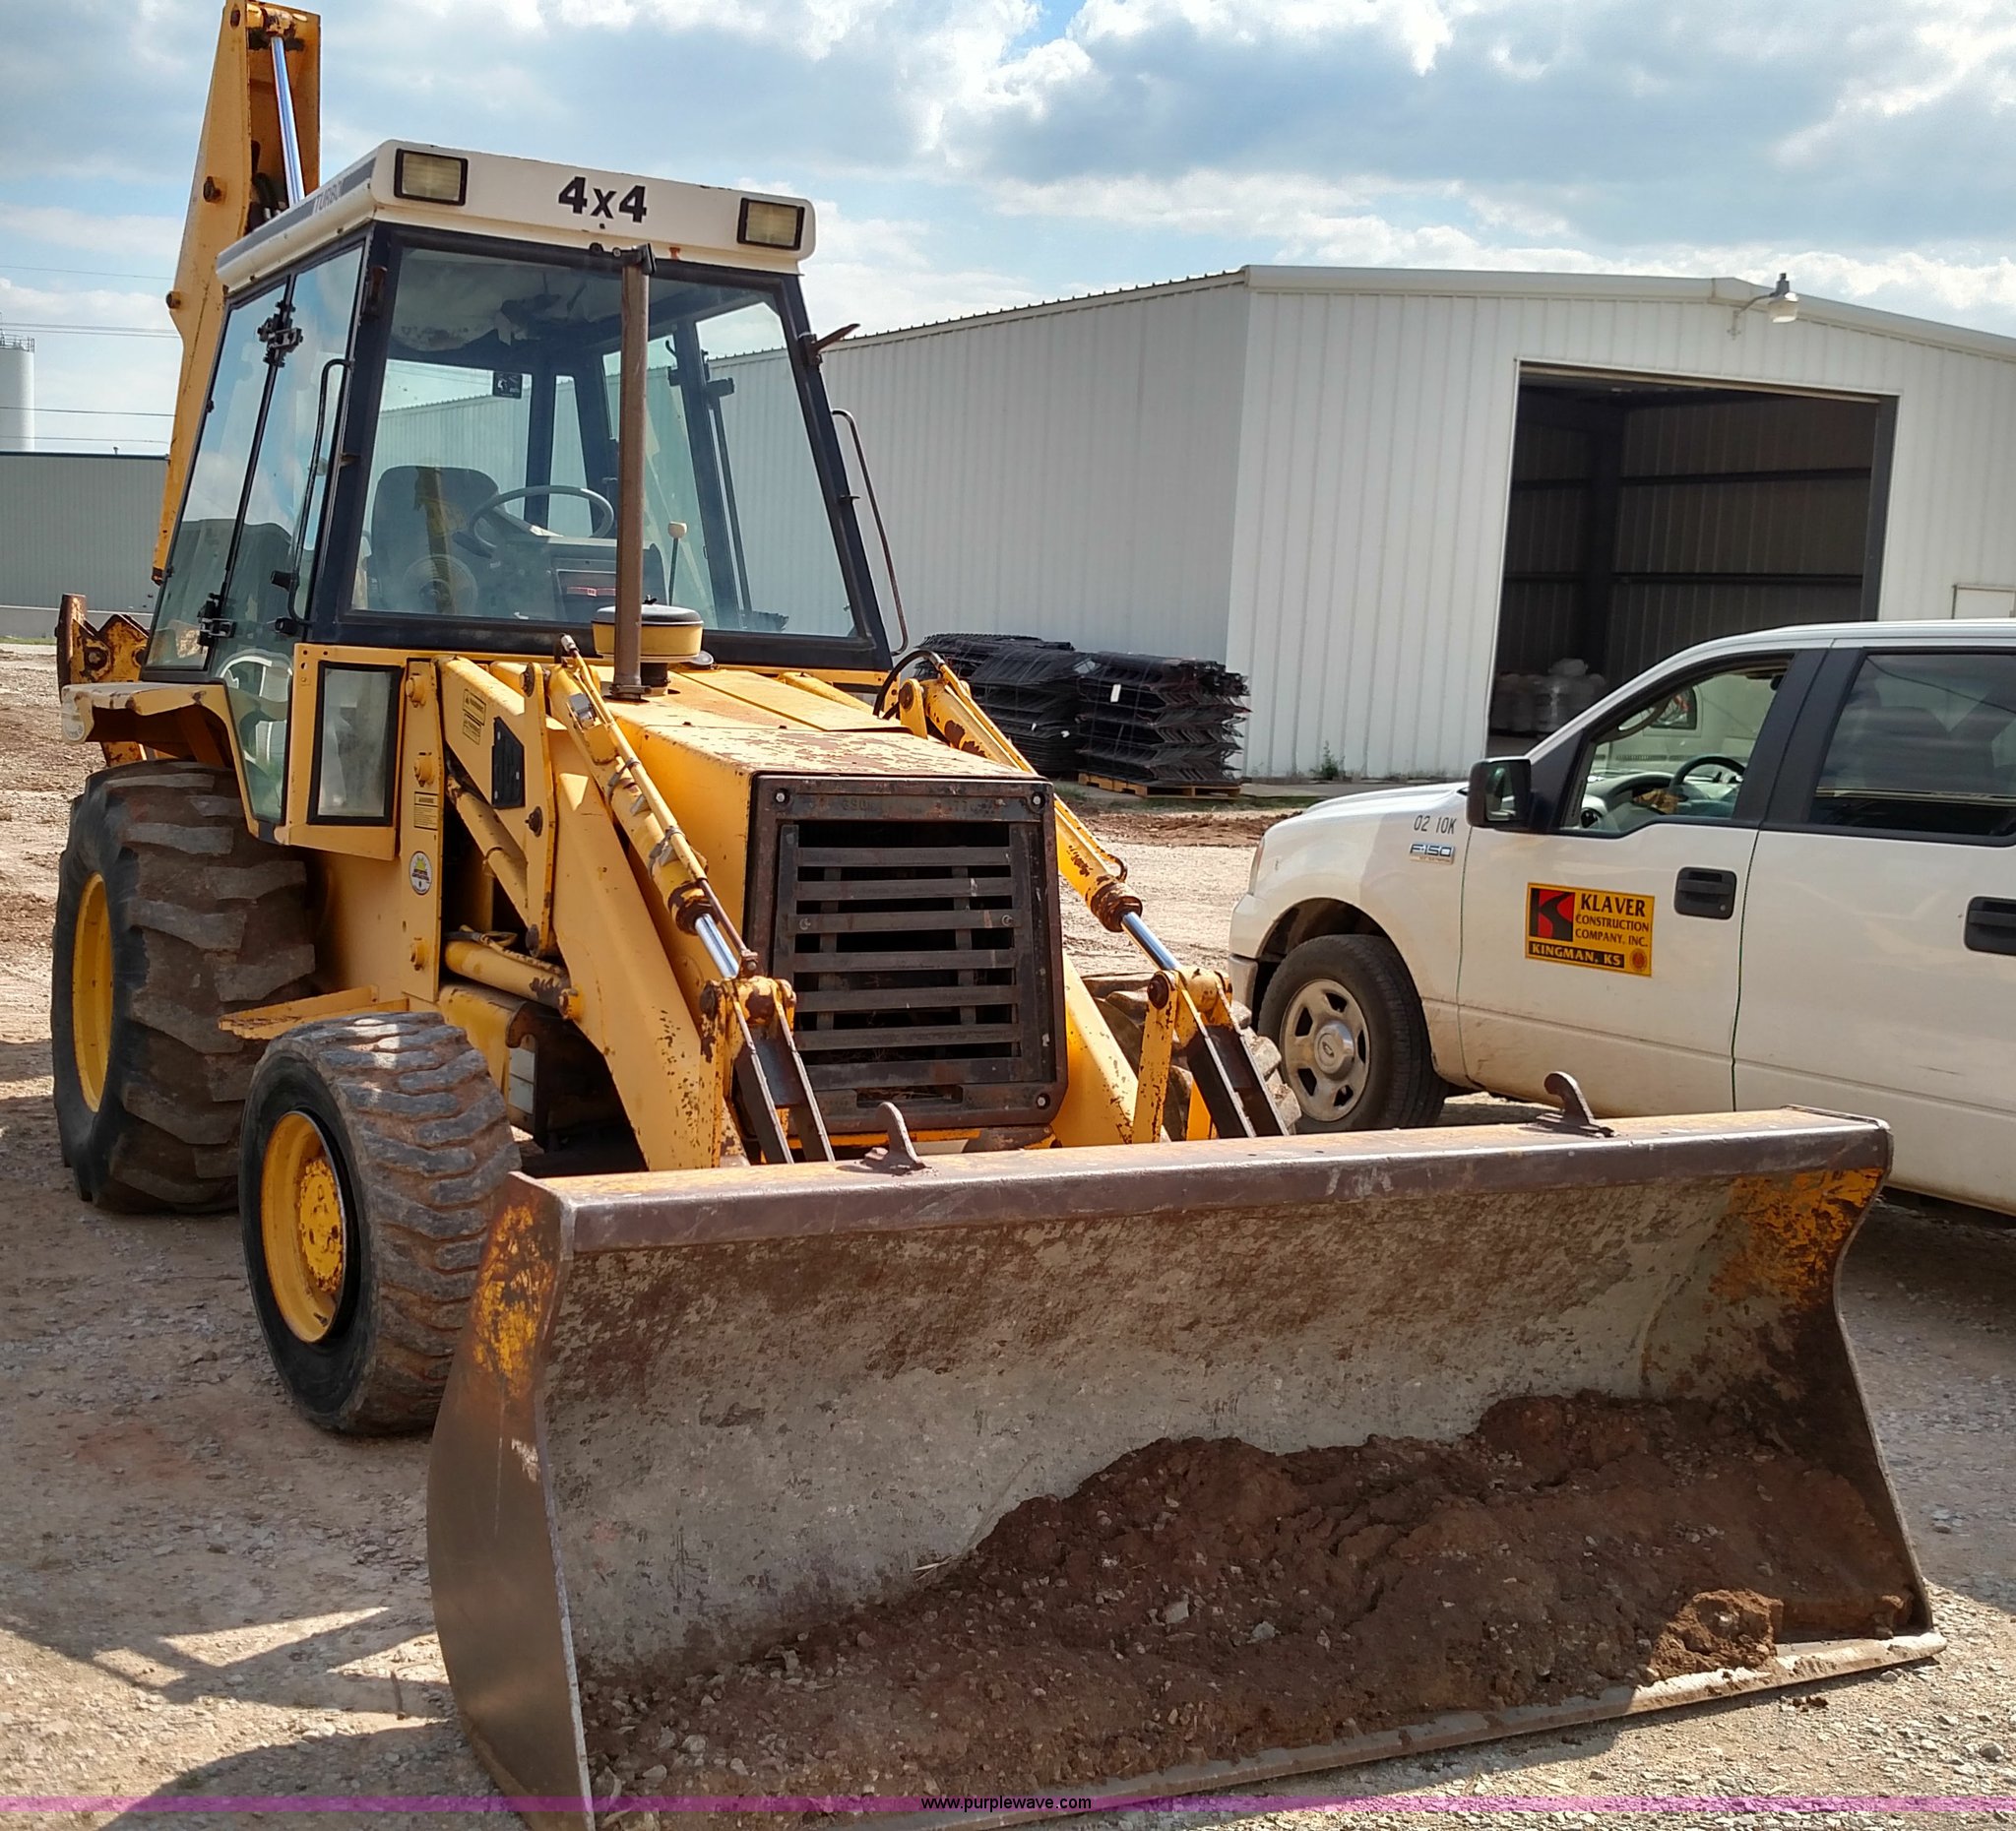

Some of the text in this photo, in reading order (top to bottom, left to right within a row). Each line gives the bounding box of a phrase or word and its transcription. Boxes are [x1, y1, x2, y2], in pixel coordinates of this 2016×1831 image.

[313, 180, 344, 214] TURBO
[558, 176, 647, 223] 4x4
[1414, 814, 1457, 835] 02 10K
[1580, 892, 1645, 917] KLAVER
[1575, 914, 1649, 932] CONSTRUCTION
[1628, 935, 1649, 947] INC.
[1604, 953, 1622, 966] KS
